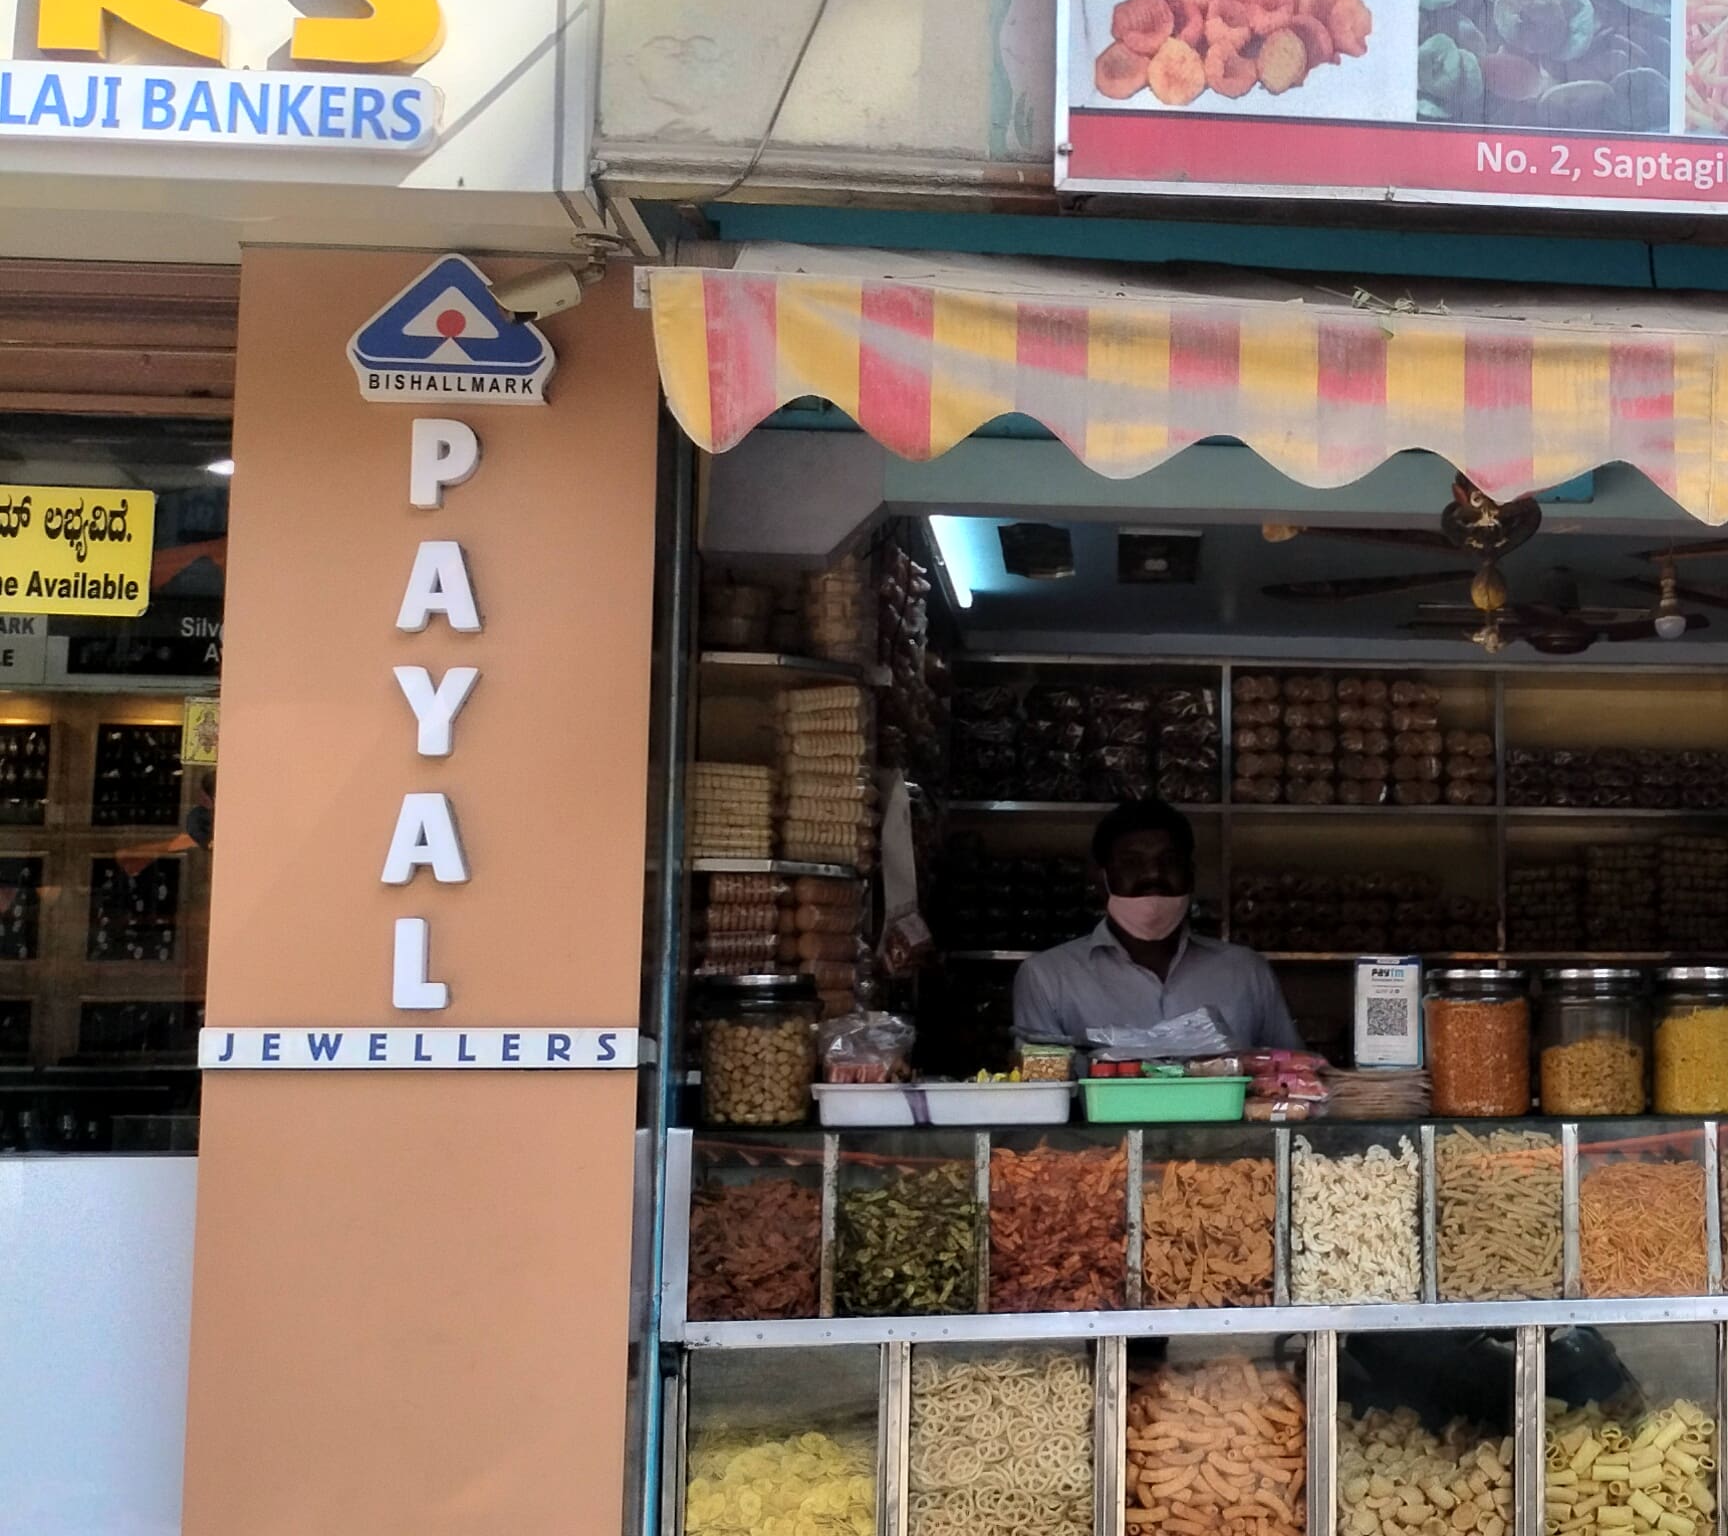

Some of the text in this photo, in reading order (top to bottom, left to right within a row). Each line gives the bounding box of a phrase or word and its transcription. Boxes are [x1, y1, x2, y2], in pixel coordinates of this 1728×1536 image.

[0, 71, 422, 141] LAJI BANKERS
[1476, 141, 1538, 175] No.
[1549, 145, 1582, 181] 2,
[368, 373, 534, 395] BISHALLMARK
[26, 570, 140, 601] Available
[180, 616, 224, 642] Silv
[380, 417, 481, 1010] PAYAL
[218, 1032, 617, 1062] JEWELLERS
